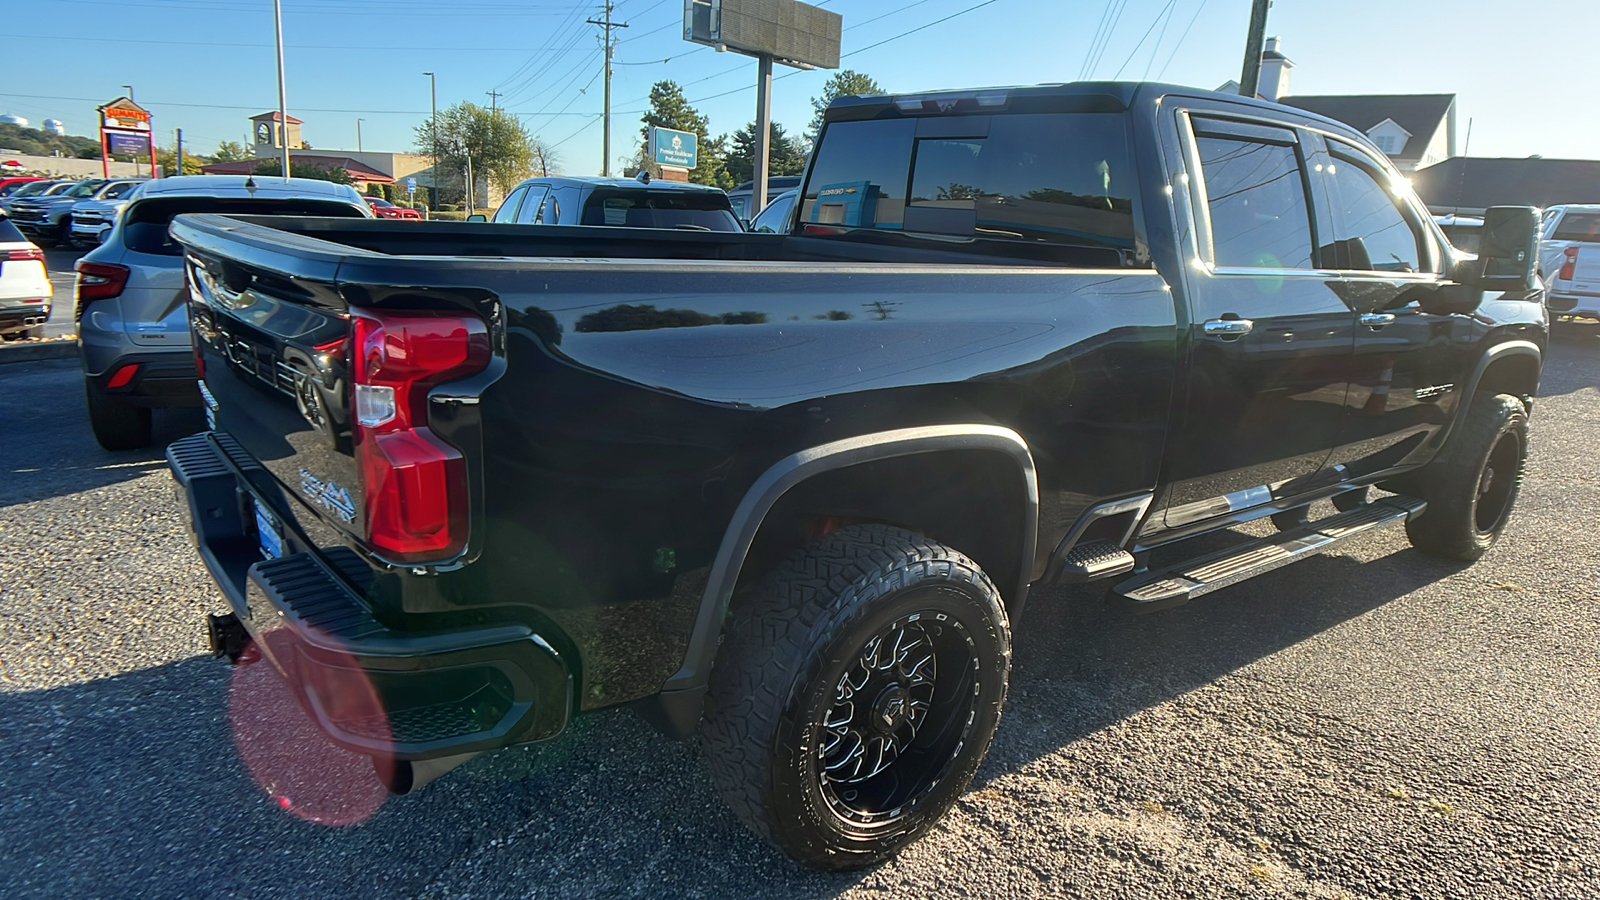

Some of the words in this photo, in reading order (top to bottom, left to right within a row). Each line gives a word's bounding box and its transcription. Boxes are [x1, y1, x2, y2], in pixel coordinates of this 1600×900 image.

[106, 108, 149, 122] SUMMITS
[660, 148, 675, 156] Premier
[675, 150, 693, 158] Healthcare
[665, 155, 688, 164] Professionals
